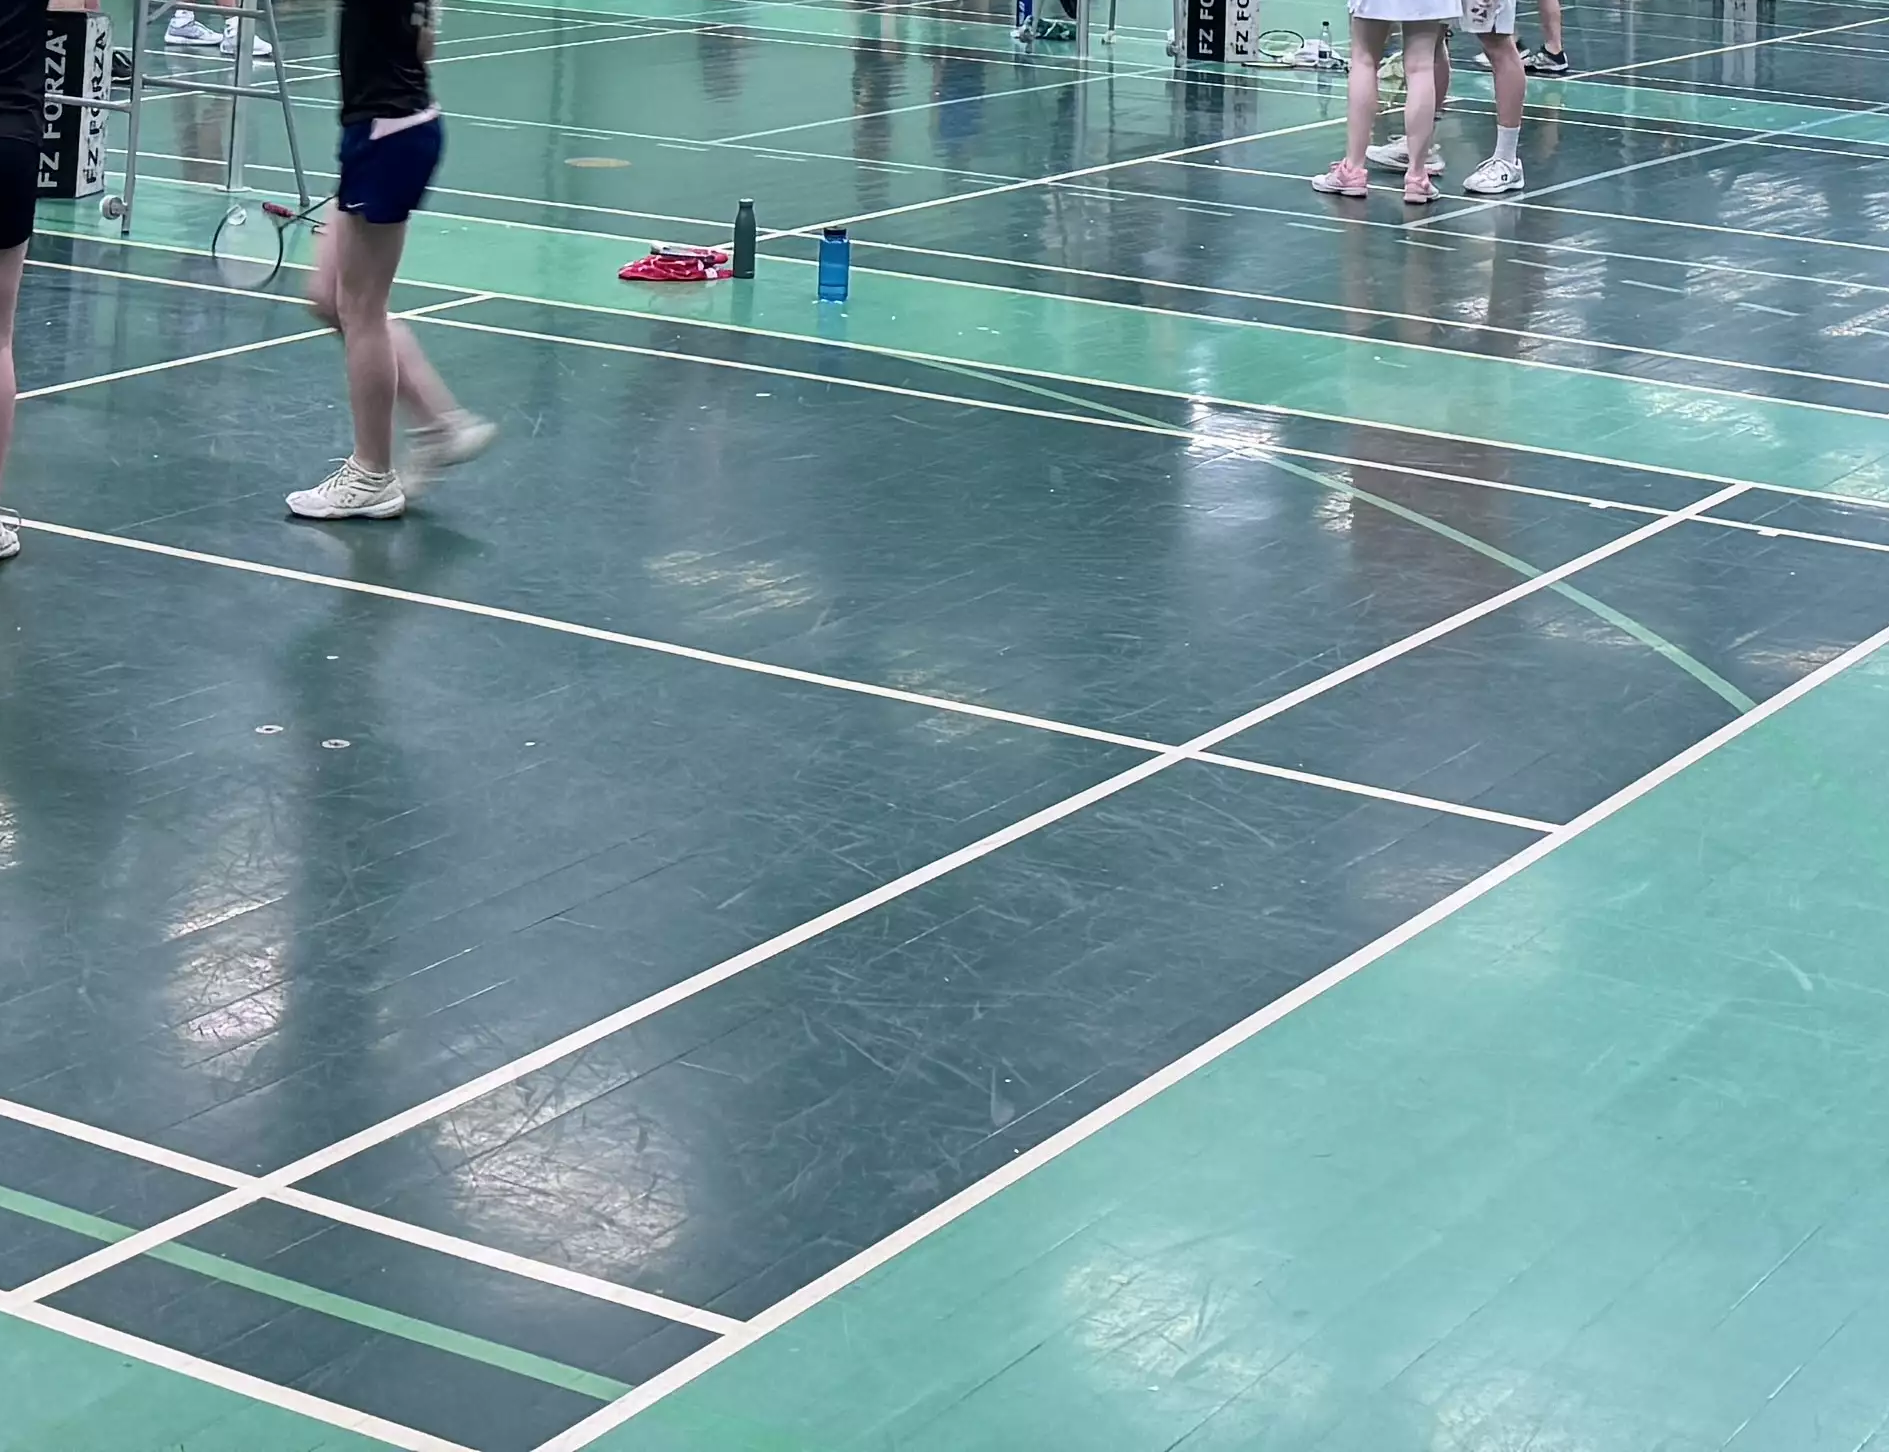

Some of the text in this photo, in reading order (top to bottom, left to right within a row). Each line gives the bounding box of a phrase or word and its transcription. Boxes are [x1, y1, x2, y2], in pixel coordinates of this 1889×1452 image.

[1198, 28, 1214, 55] FZ
[1235, 30, 1249, 56] FZ
[37, 33, 69, 189] FZ FORZA
[83, 31, 107, 185] FZ FORZA
